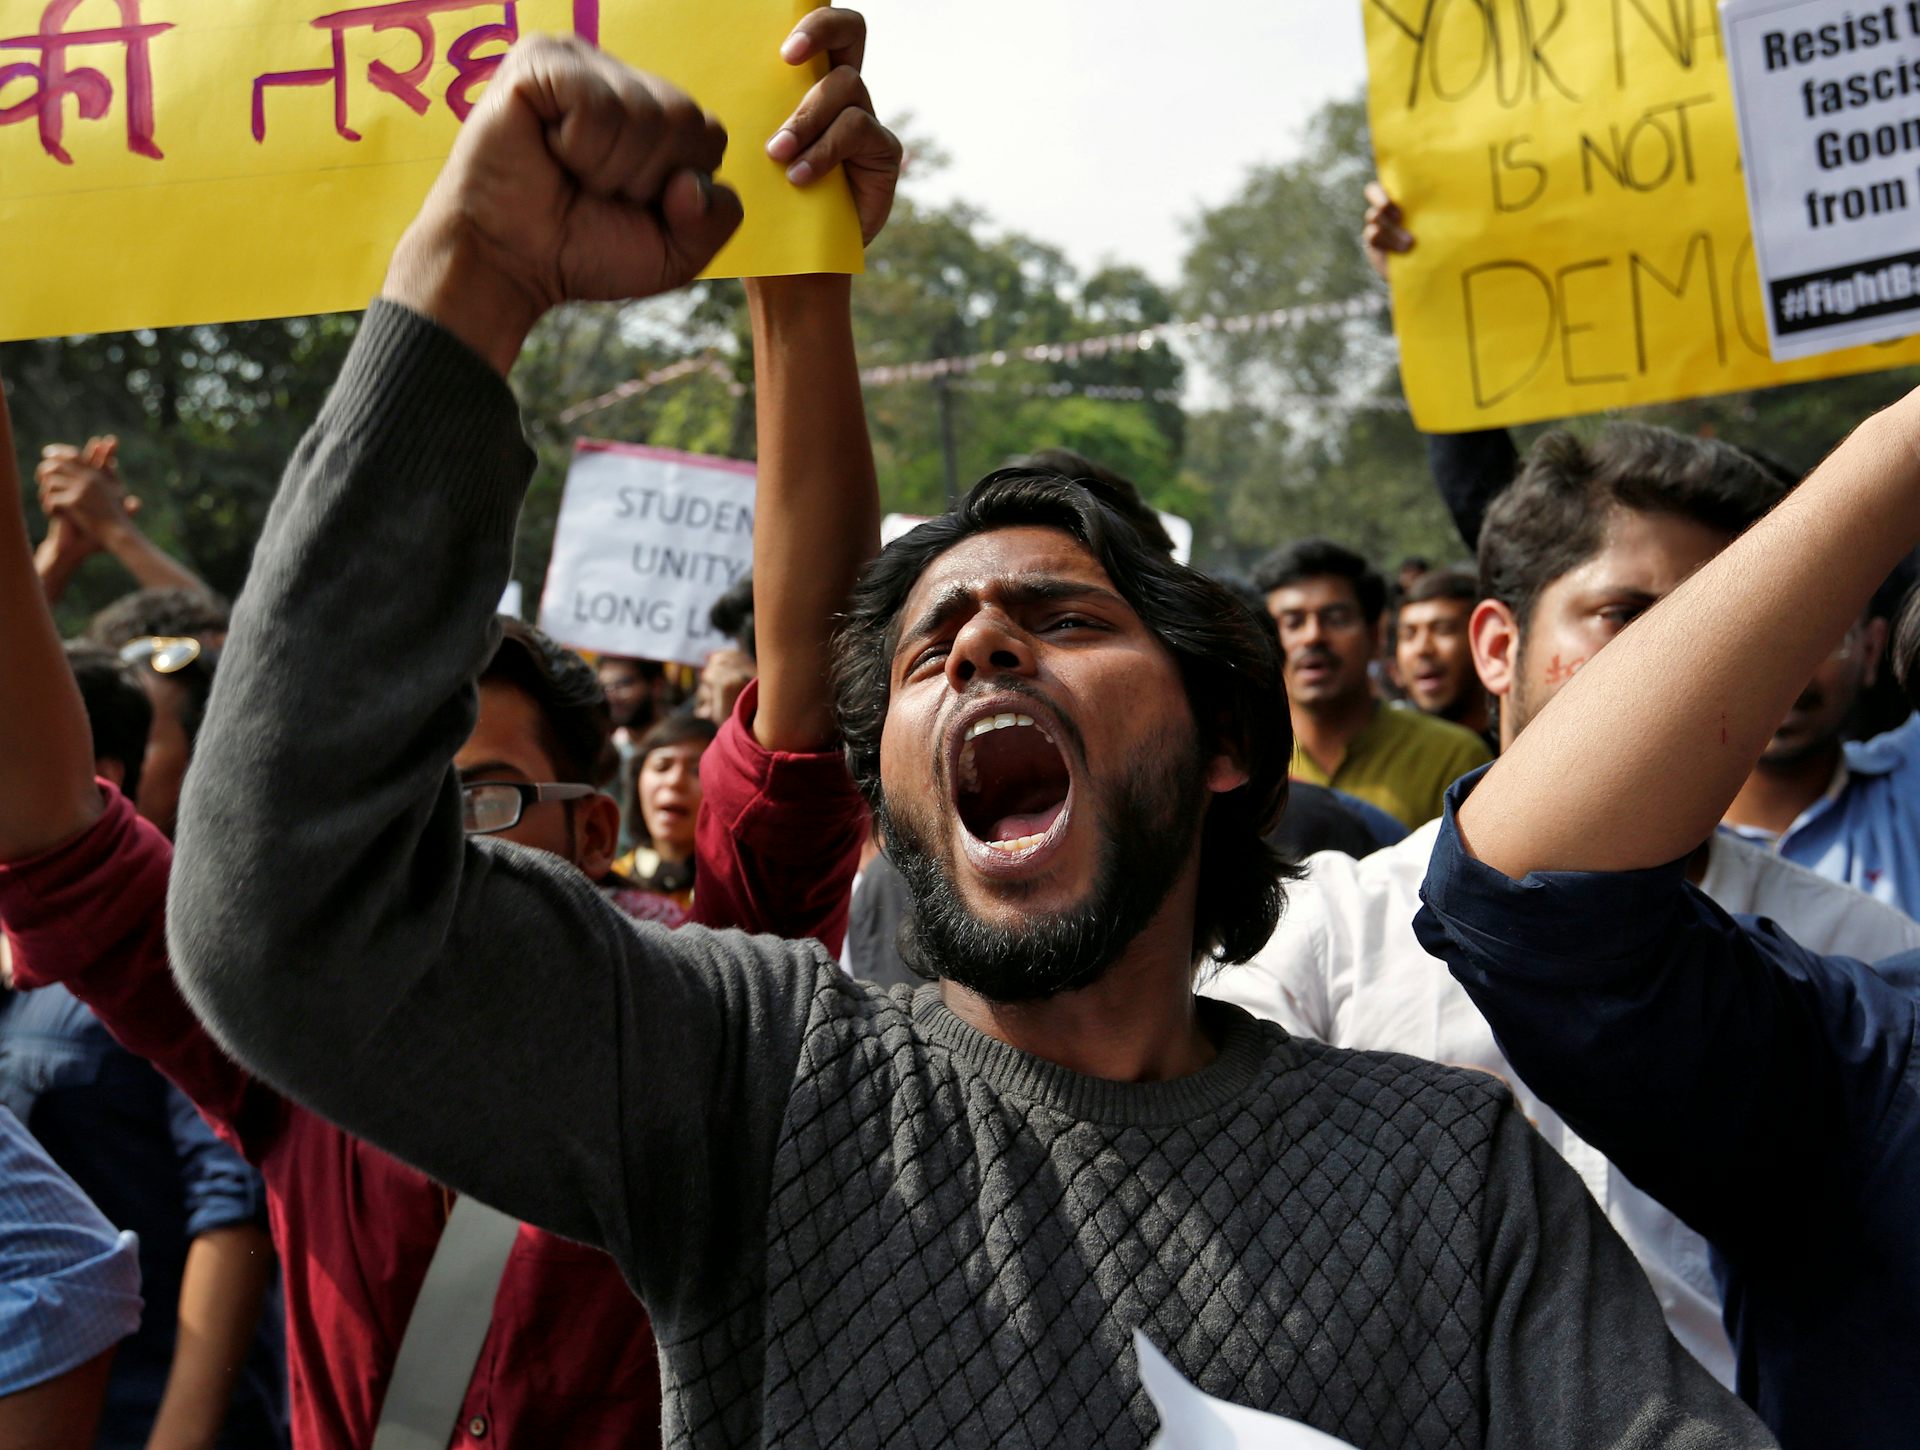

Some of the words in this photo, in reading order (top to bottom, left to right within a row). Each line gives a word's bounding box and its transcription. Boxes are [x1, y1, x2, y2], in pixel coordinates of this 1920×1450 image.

[1371, 0, 1583, 111] YOUR
[1762, 5, 1899, 71] Resist
[1489, 134, 1548, 213] IS
[1580, 92, 1716, 194] NOT
[1804, 176, 1907, 229] from
[631, 543, 744, 588] UNITY
[573, 592, 673, 635] LONG
